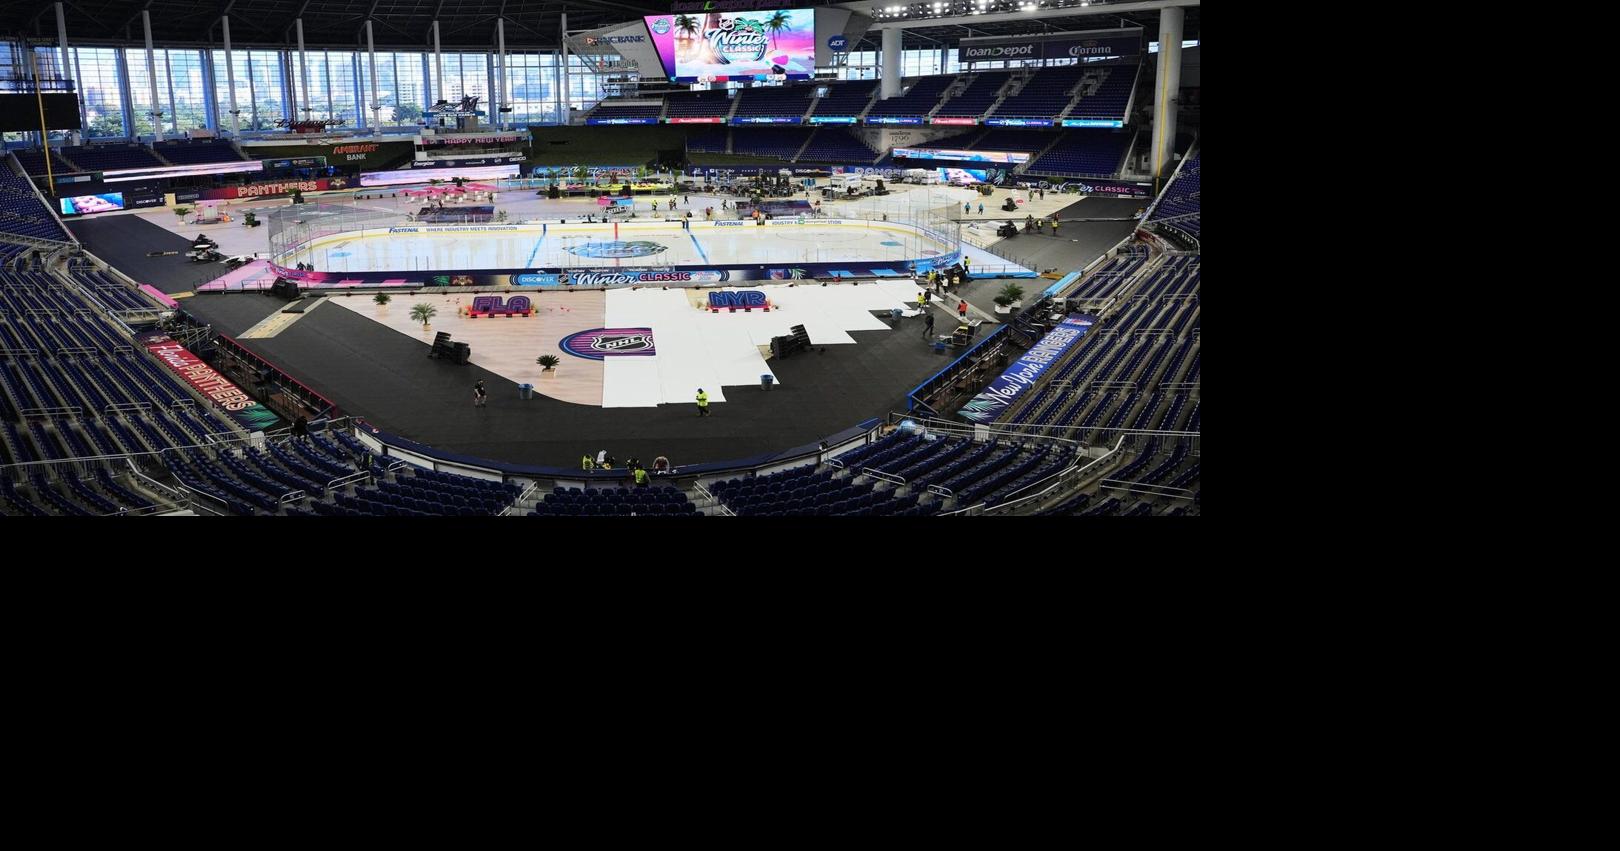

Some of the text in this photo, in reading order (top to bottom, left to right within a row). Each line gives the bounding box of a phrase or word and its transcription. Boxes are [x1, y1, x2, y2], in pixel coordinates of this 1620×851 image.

[705, 28, 769, 45] Winter
[723, 45, 761, 53] CLASSIC
[966, 44, 1034, 57] loanDepot
[1068, 45, 1112, 56] Corona
[346, 153, 366, 161] BANK
[237, 181, 318, 197] PANTHERS
[1094, 185, 1130, 194] CLASSIC
[572, 272, 638, 285] Winter
[639, 272, 691, 281] CLASSIC
[472, 296, 530, 314] FLA
[709, 291, 767, 307] NYR
[604, 337, 644, 350] NHL
[985, 327, 1080, 405] New York RANGERS
[150, 344, 257, 411] Florida PANTHERS
